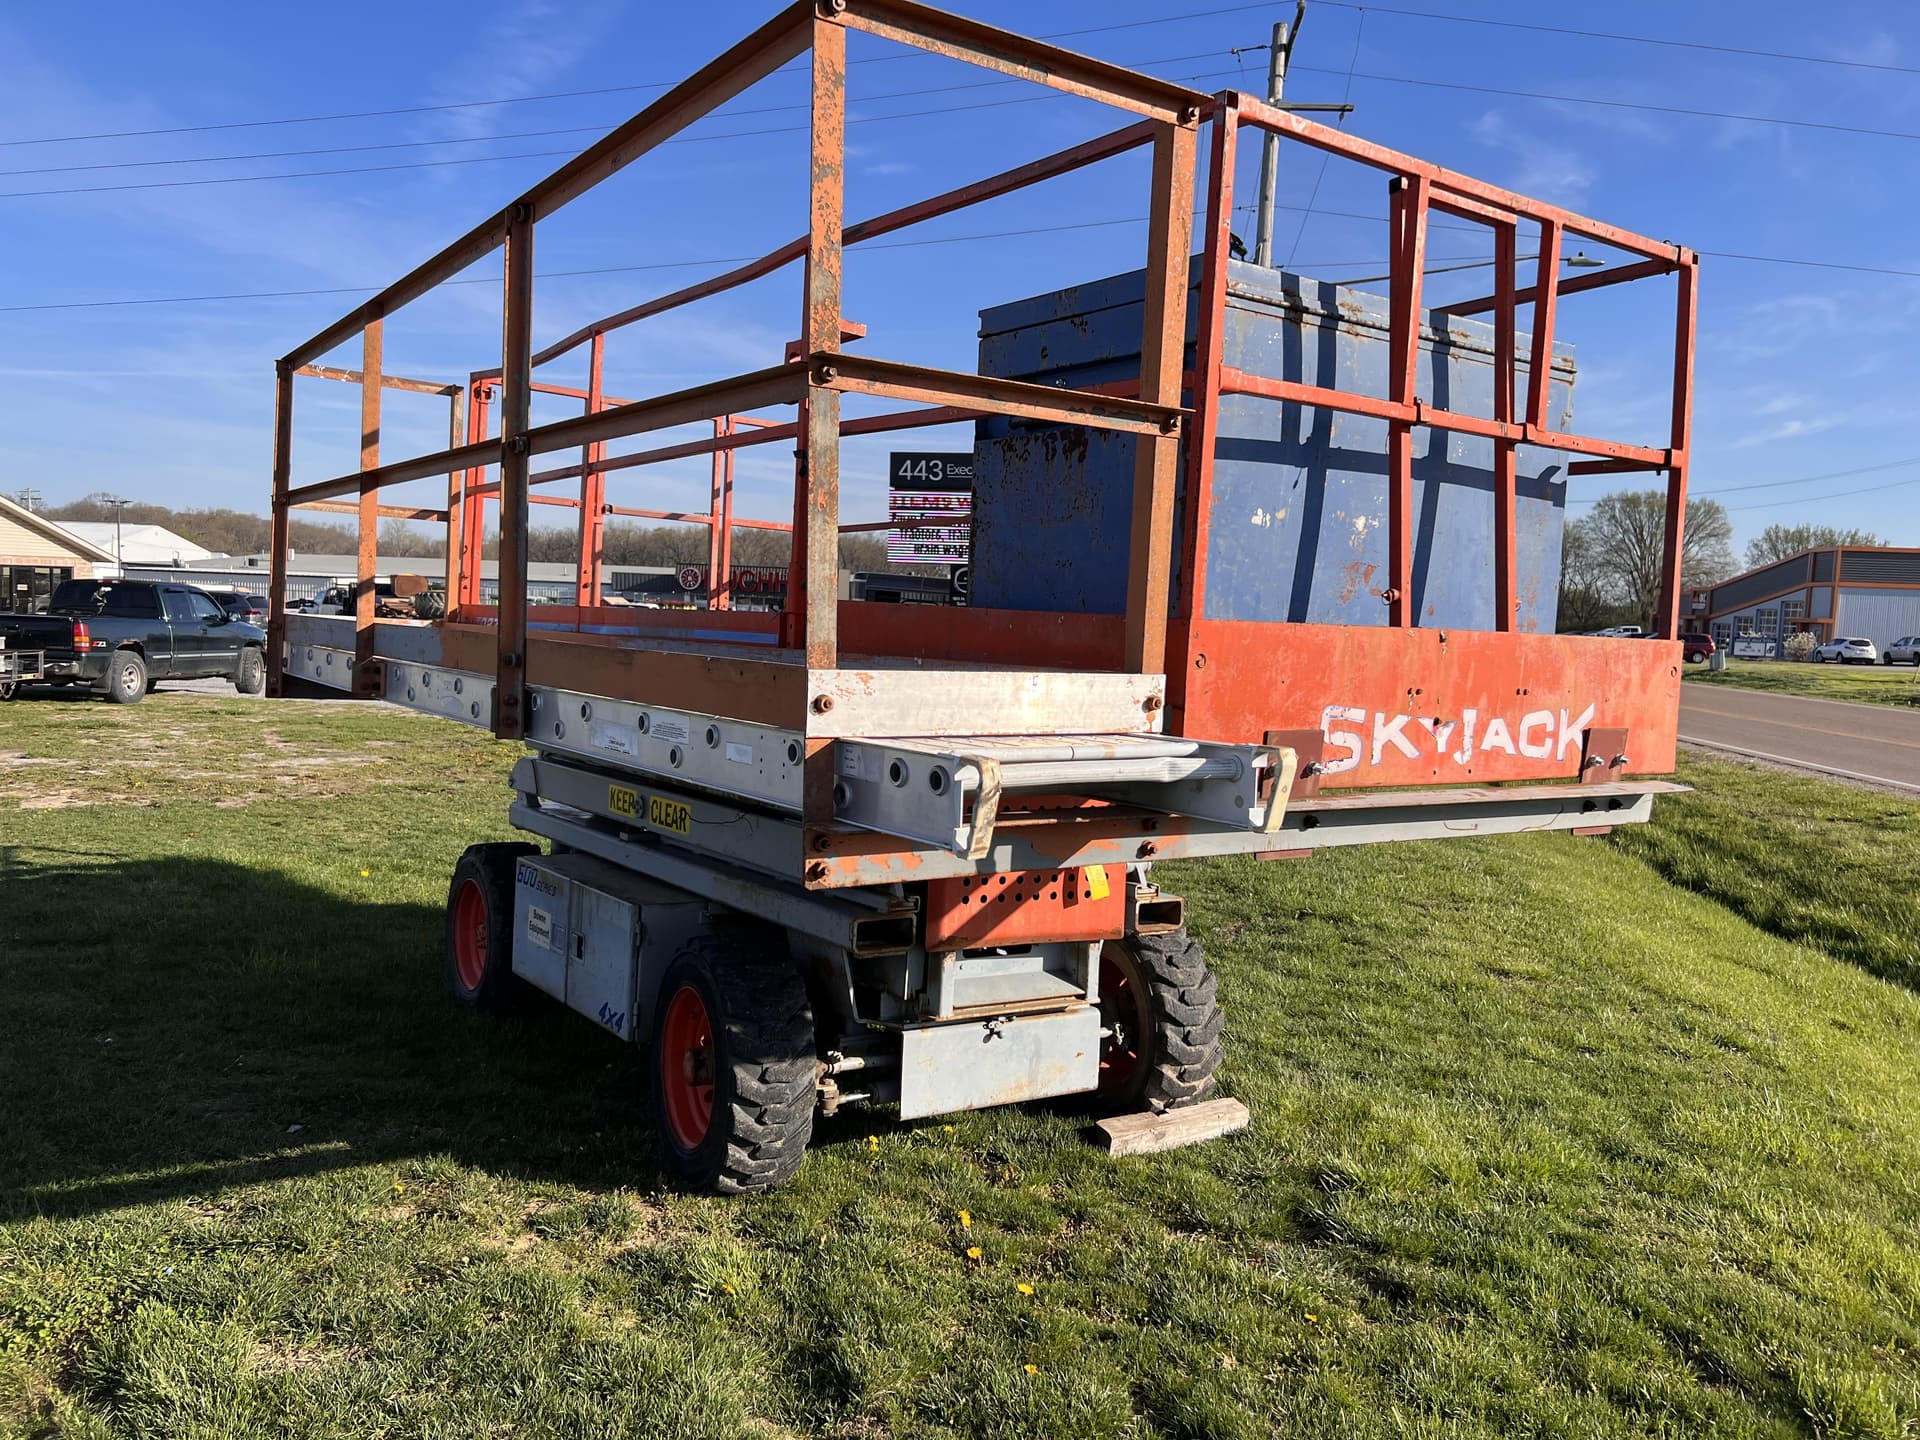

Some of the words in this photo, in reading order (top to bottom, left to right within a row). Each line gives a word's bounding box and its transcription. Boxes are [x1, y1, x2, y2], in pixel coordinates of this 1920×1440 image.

[898, 459, 943, 481] 443
[946, 464, 973, 475] Exec
[1319, 703, 1596, 776] SKYJACK
[609, 786, 635, 814] KEEP
[650, 799, 687, 832] CLEAR
